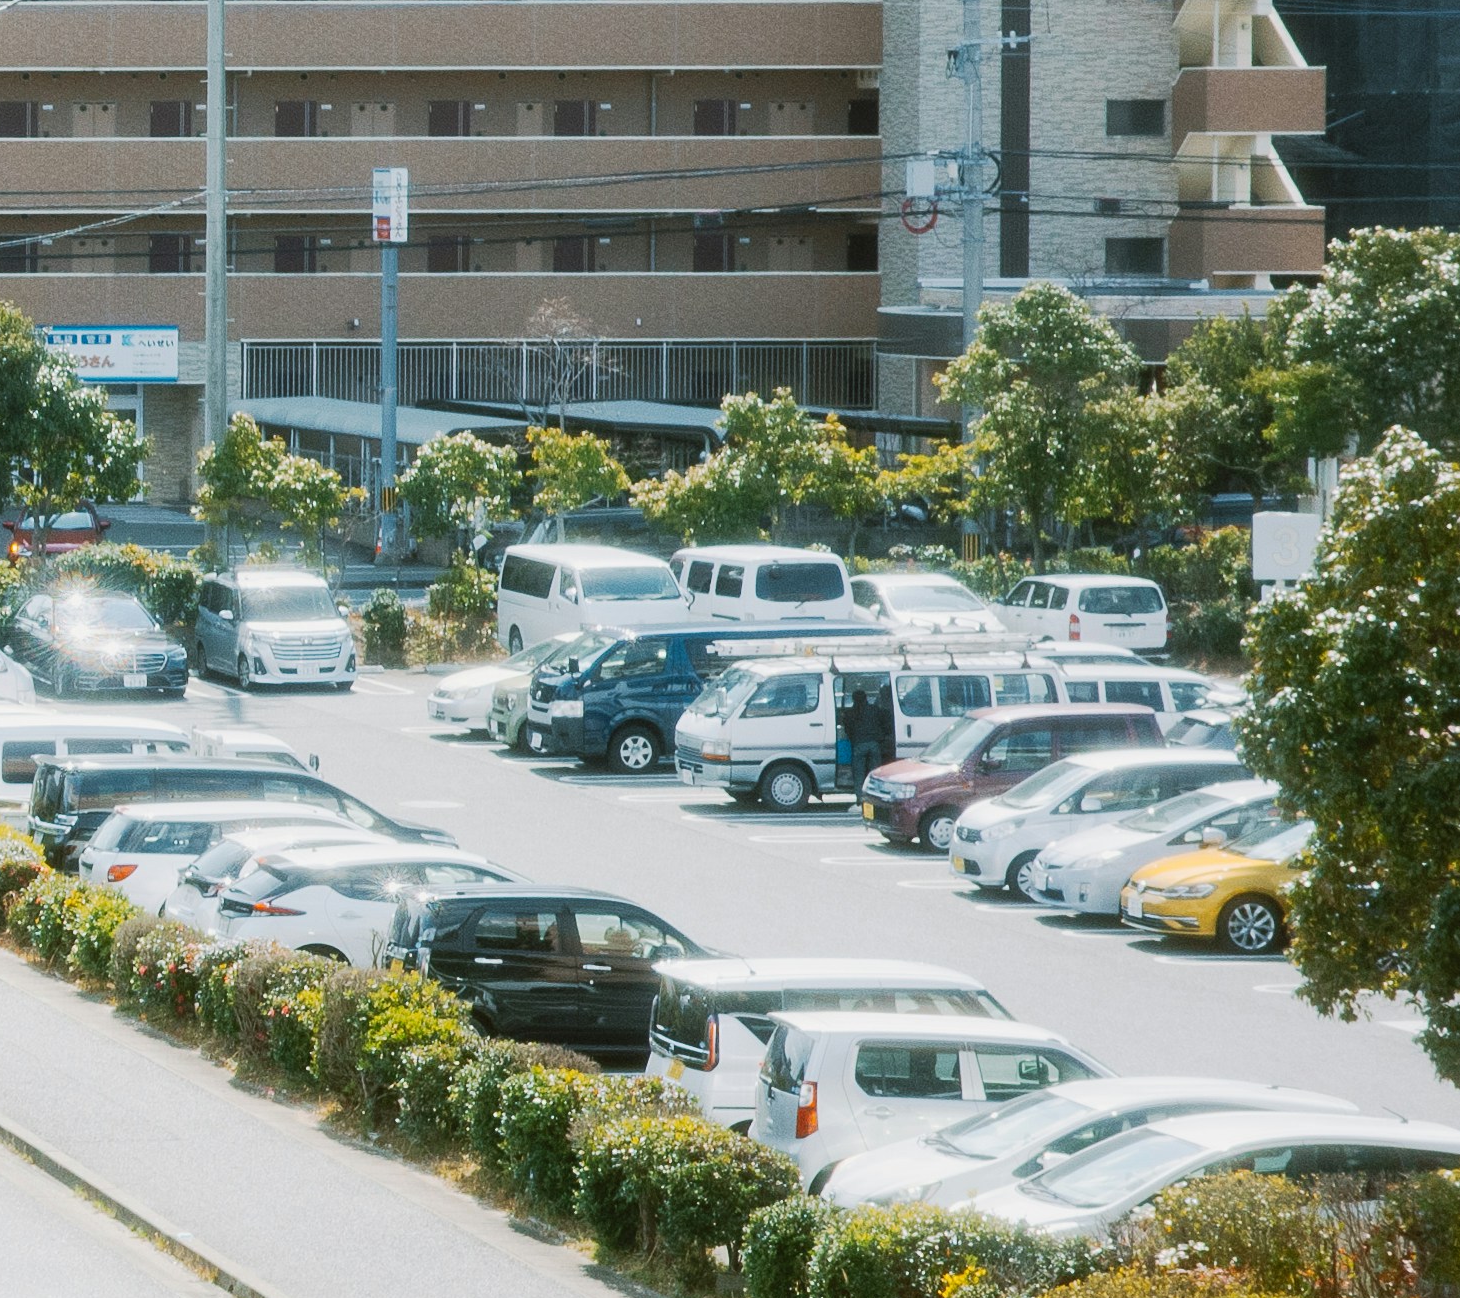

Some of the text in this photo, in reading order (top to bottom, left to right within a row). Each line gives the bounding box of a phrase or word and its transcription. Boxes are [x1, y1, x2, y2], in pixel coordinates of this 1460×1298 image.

[138, 339, 174, 347] へいせい
[1272, 525, 1299, 567] 3
